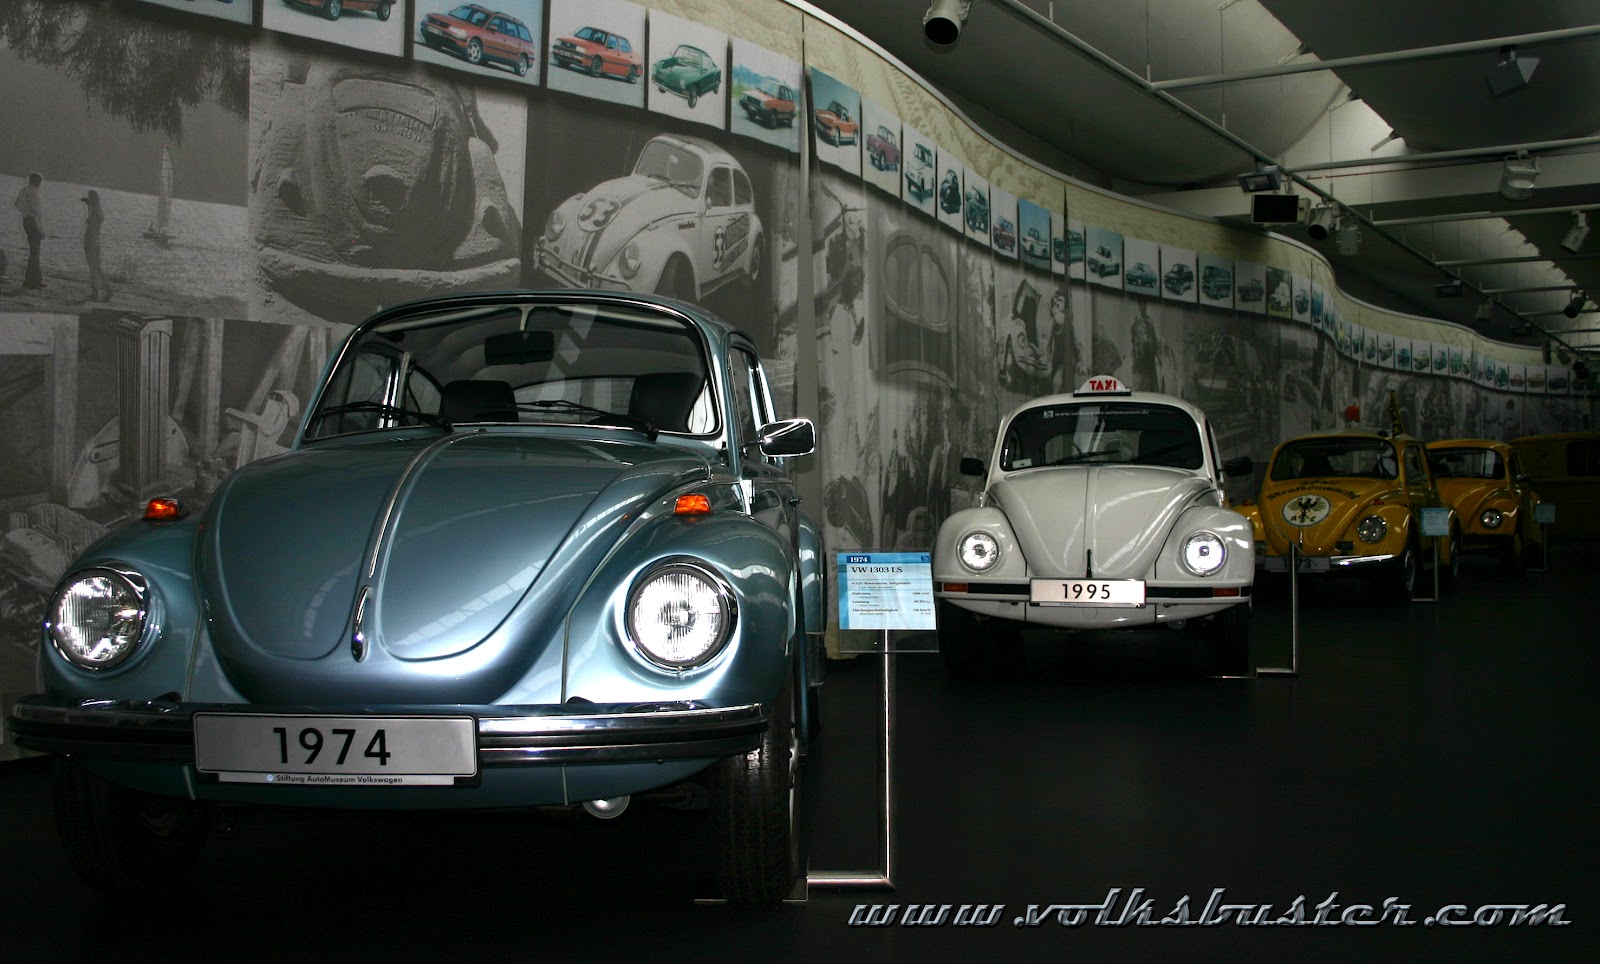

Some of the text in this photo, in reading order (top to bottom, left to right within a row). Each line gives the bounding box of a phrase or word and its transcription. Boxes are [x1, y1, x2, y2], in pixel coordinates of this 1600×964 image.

[578, 200, 620, 227] 53
[1089, 380, 1117, 391] TAXI
[1283, 558, 1312, 569] 173
[1062, 583, 1110, 599] 1995
[273, 727, 391, 766] 1974
[276, 775, 306, 784] Stiftung
[357, 776, 403, 784] Volkswagen
